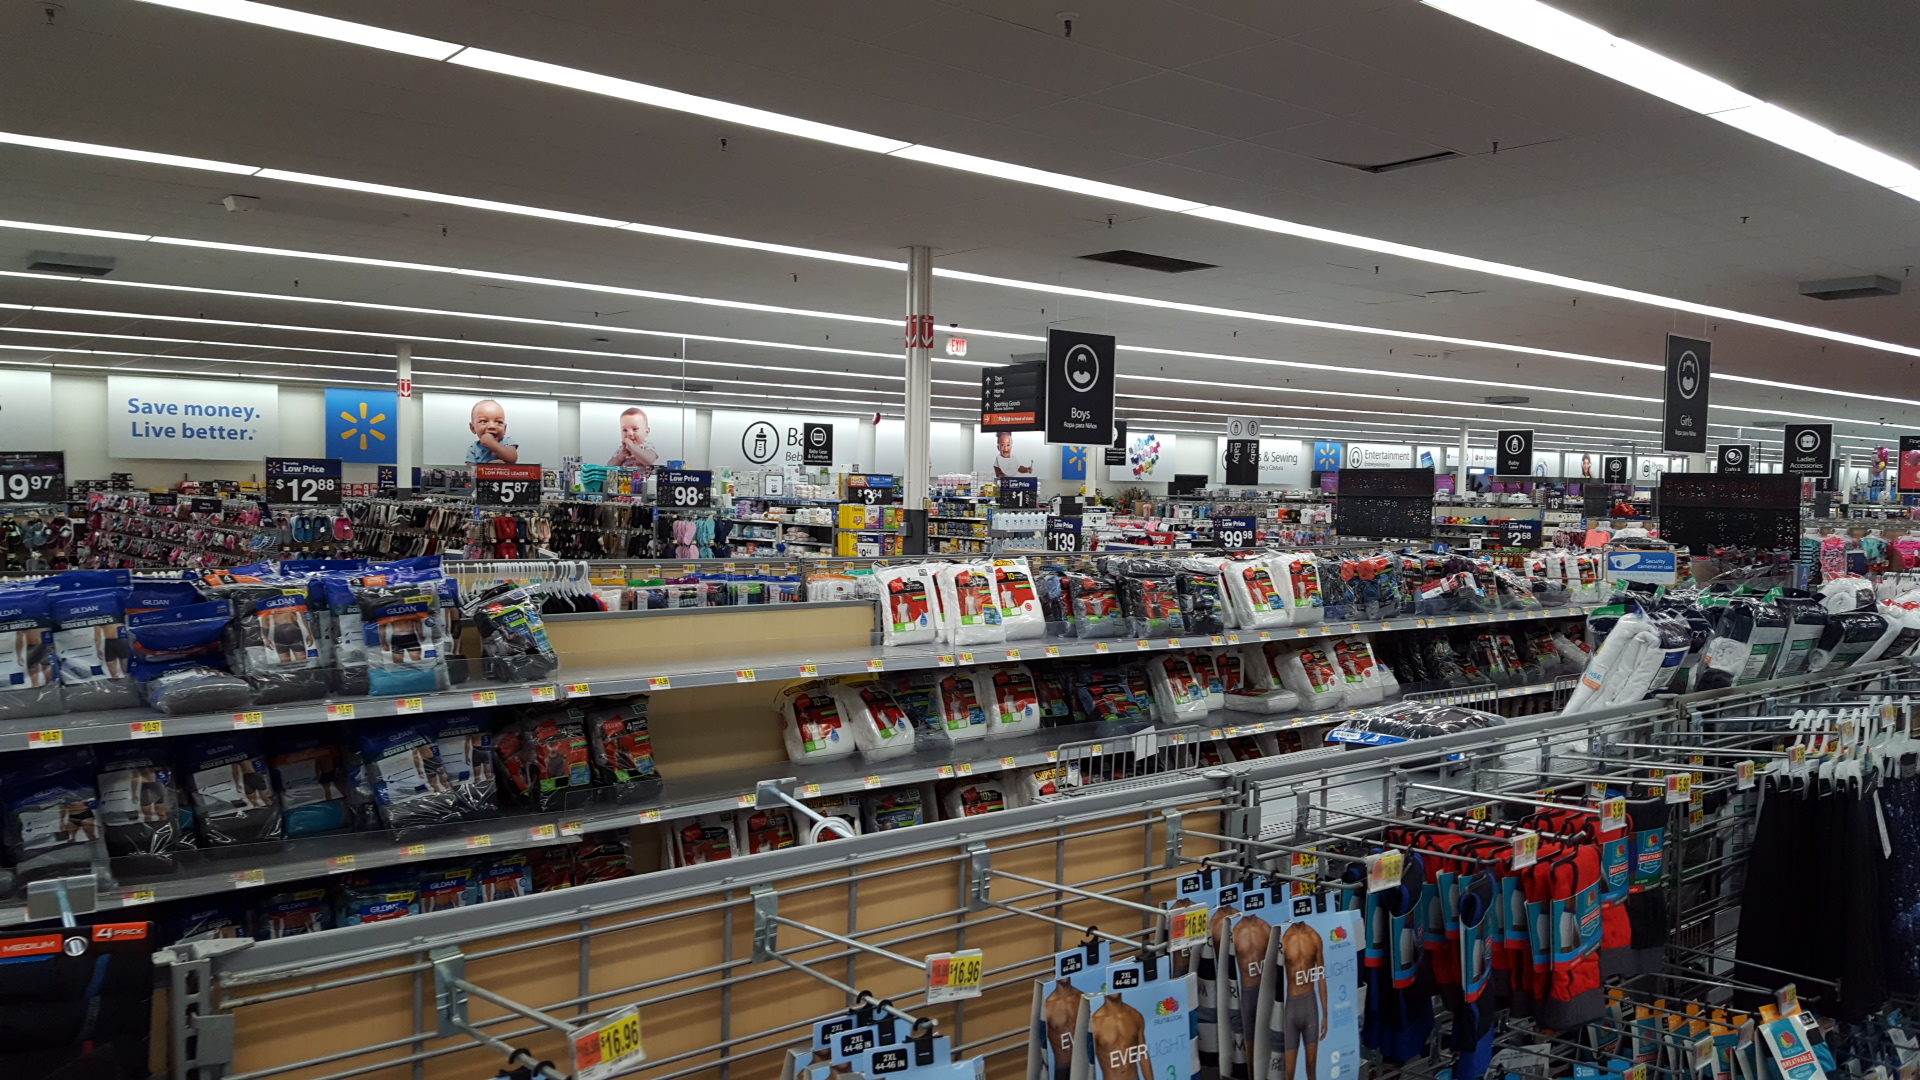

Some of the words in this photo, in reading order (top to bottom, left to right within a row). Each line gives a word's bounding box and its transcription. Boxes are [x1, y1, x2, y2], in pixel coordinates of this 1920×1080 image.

[951, 339, 967, 353] EXIT
[127, 398, 178, 416] Save
[184, 404, 261, 422] money.
[1071, 407, 1091, 421] Boys
[1063, 421, 1074, 430] Ropa
[1074, 423, 1085, 431] para
[1680, 414, 1693, 427] Girls
[131, 421, 177, 439] Live
[182, 422, 254, 441] better.
[1232, 442, 1242, 465] Baby
[1248, 442, 1258, 465] Baby
[1271, 451, 1298, 466] Sewing
[1364, 449, 1410, 461] Entertainment
[282, 465, 302, 473] Low
[303, 465, 325, 473] Price
[683, 475, 700, 483] Price
[266, 598, 296, 608] GILDAN
[70, 605, 99, 615] GILDAN
[386, 605, 417, 615] GILDAN
[10, 620, 38, 630] BRIEFS
[61, 620, 87, 630] BOXER
[87, 616, 114, 626] BRIEFS
[540, 687, 555, 697] 10.97
[574, 683, 590, 693] 14.98
[479, 692, 496, 702] 10.97
[337, 704, 354, 715] 10.97
[405, 699, 422, 709] 10.97
[244, 713, 261, 723] 10.97
[142, 722, 160, 732] 10.97
[41, 731, 61, 741] 10.97
[388, 730, 414, 742] GILDAN
[489, 866, 514, 877] GILDAN
[429, 879, 458, 890] GILDAN
[369, 903, 399, 914] GILDAN
[96, 926, 113, 939] 4
[114, 927, 144, 936] PACK
[4, 940, 55, 952] MEDIUM
[1066, 957, 1076, 966] 2XL
[950, 960, 980, 985] $16.96
[1062, 964, 1076, 974] 44-46
[1120, 971, 1131, 980] 2XL
[1114, 978, 1131, 986] 44-46
[831, 1023, 843, 1033] 2XL
[600, 1020, 640, 1058] $16.96
[850, 1035, 864, 1044] 2XL
[843, 1043, 864, 1053] 44-46
[882, 1053, 898, 1062] 2XL
[1781, 1053, 1813, 1069] BREATHABLE
[874, 1061, 899, 1070] 44-46
[899, 1059, 906, 1068] IN
[1166, 1064, 1178, 1080] 3
